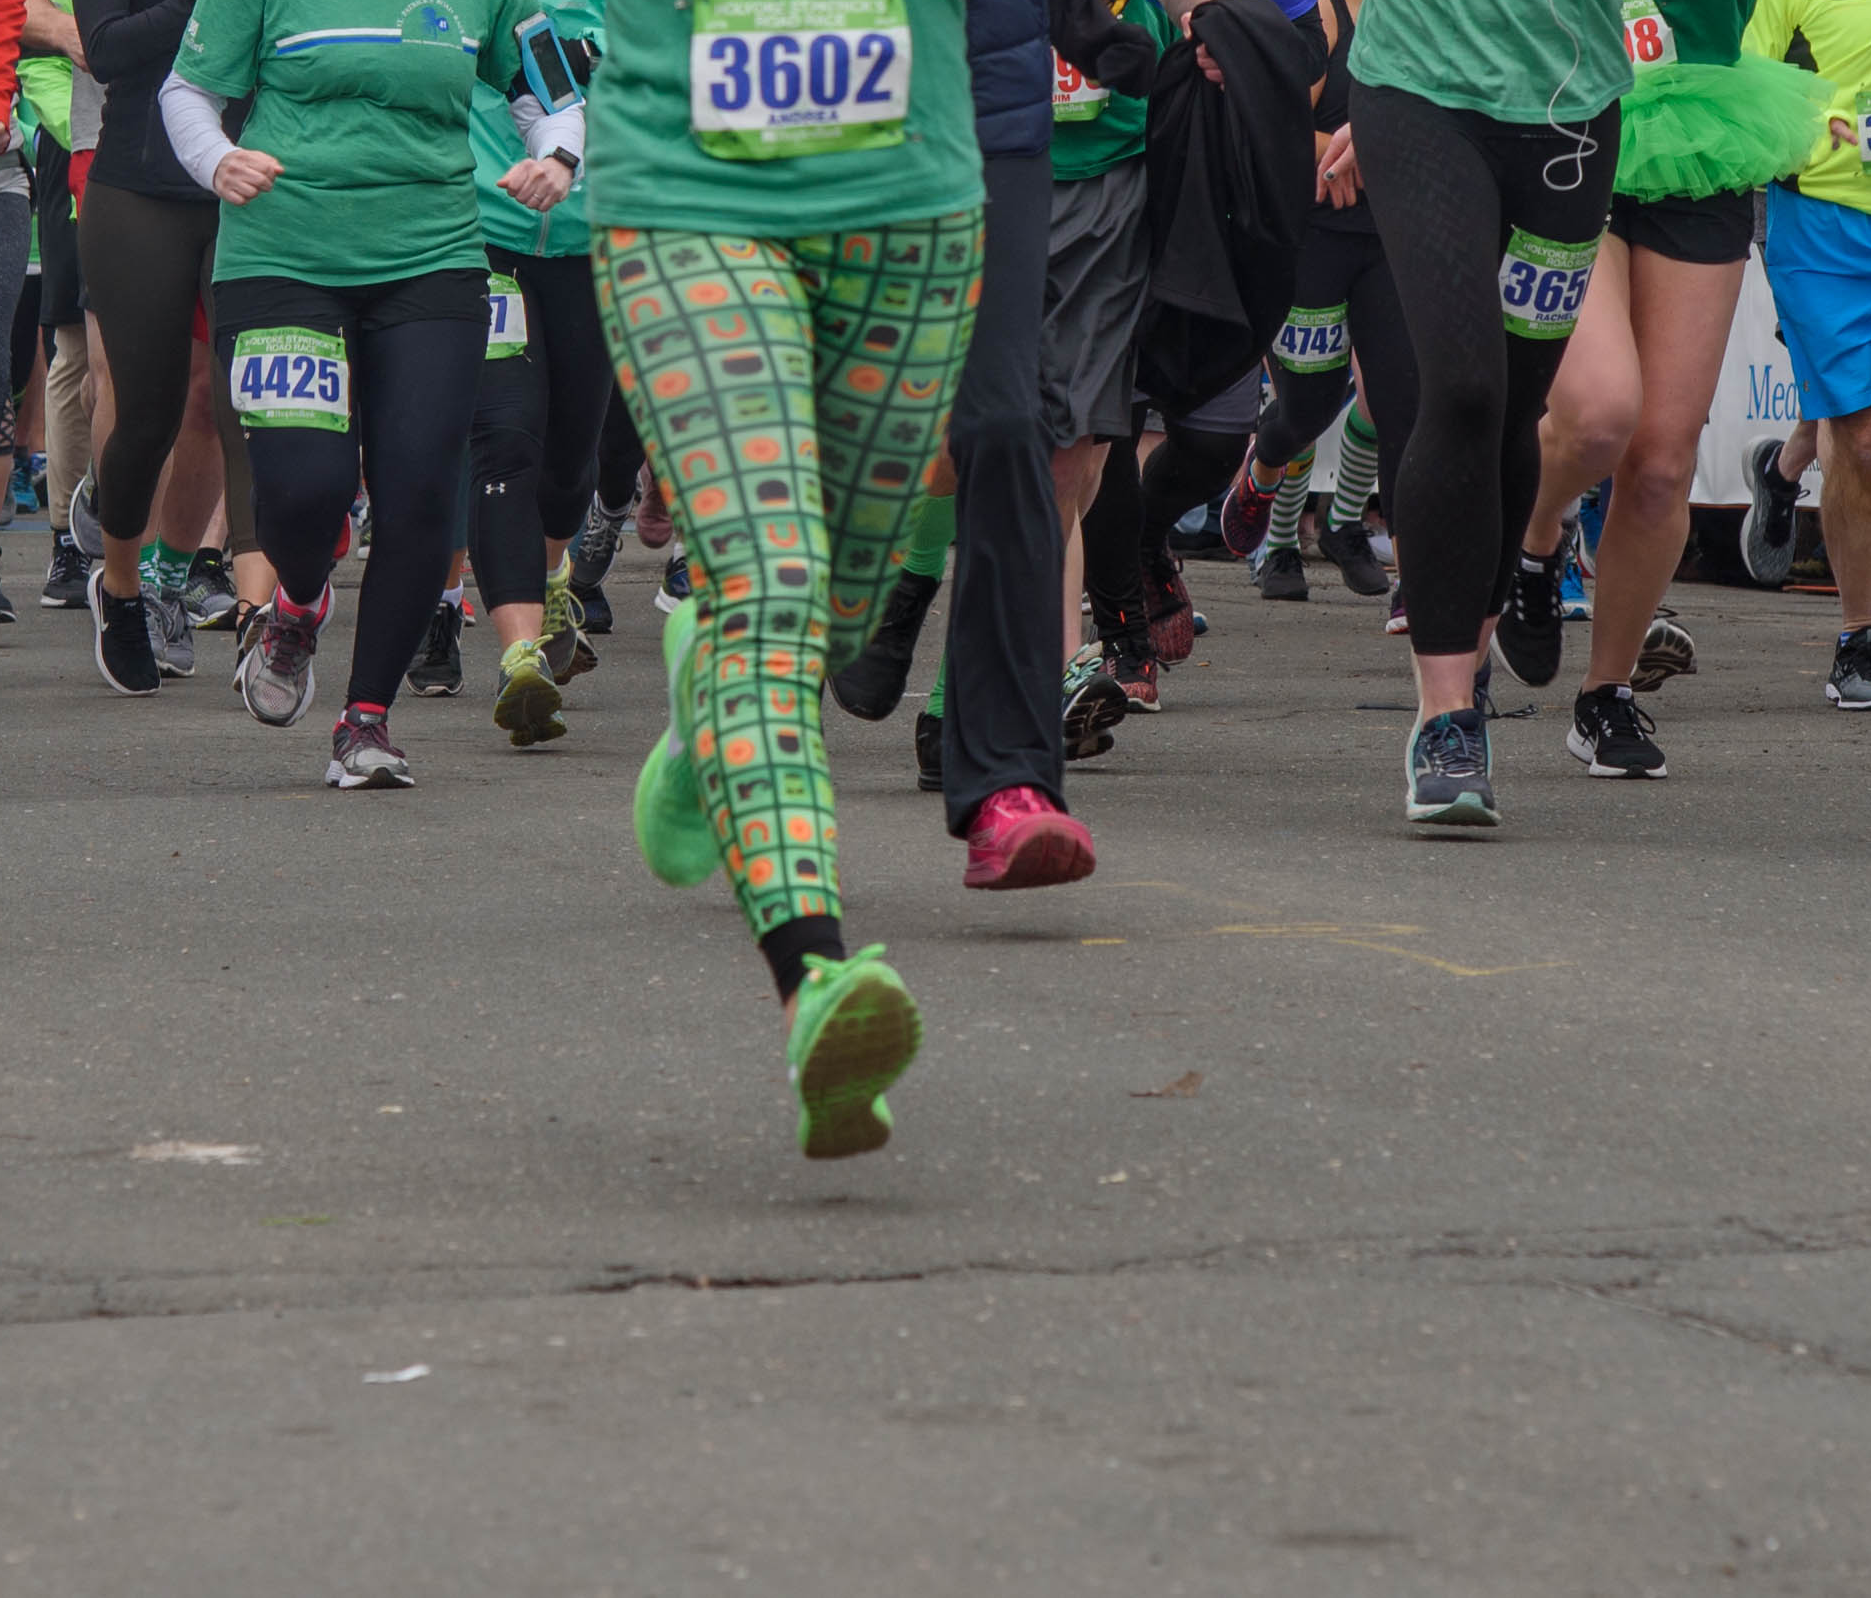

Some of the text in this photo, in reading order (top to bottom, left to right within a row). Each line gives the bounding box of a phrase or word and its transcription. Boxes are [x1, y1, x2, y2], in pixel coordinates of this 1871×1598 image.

[708, 33, 896, 112] 3602
[767, 110, 839, 126] ANDREA
[1503, 260, 1594, 313] 365
[1279, 324, 1343, 356] 4742
[239, 354, 340, 403] 4425
